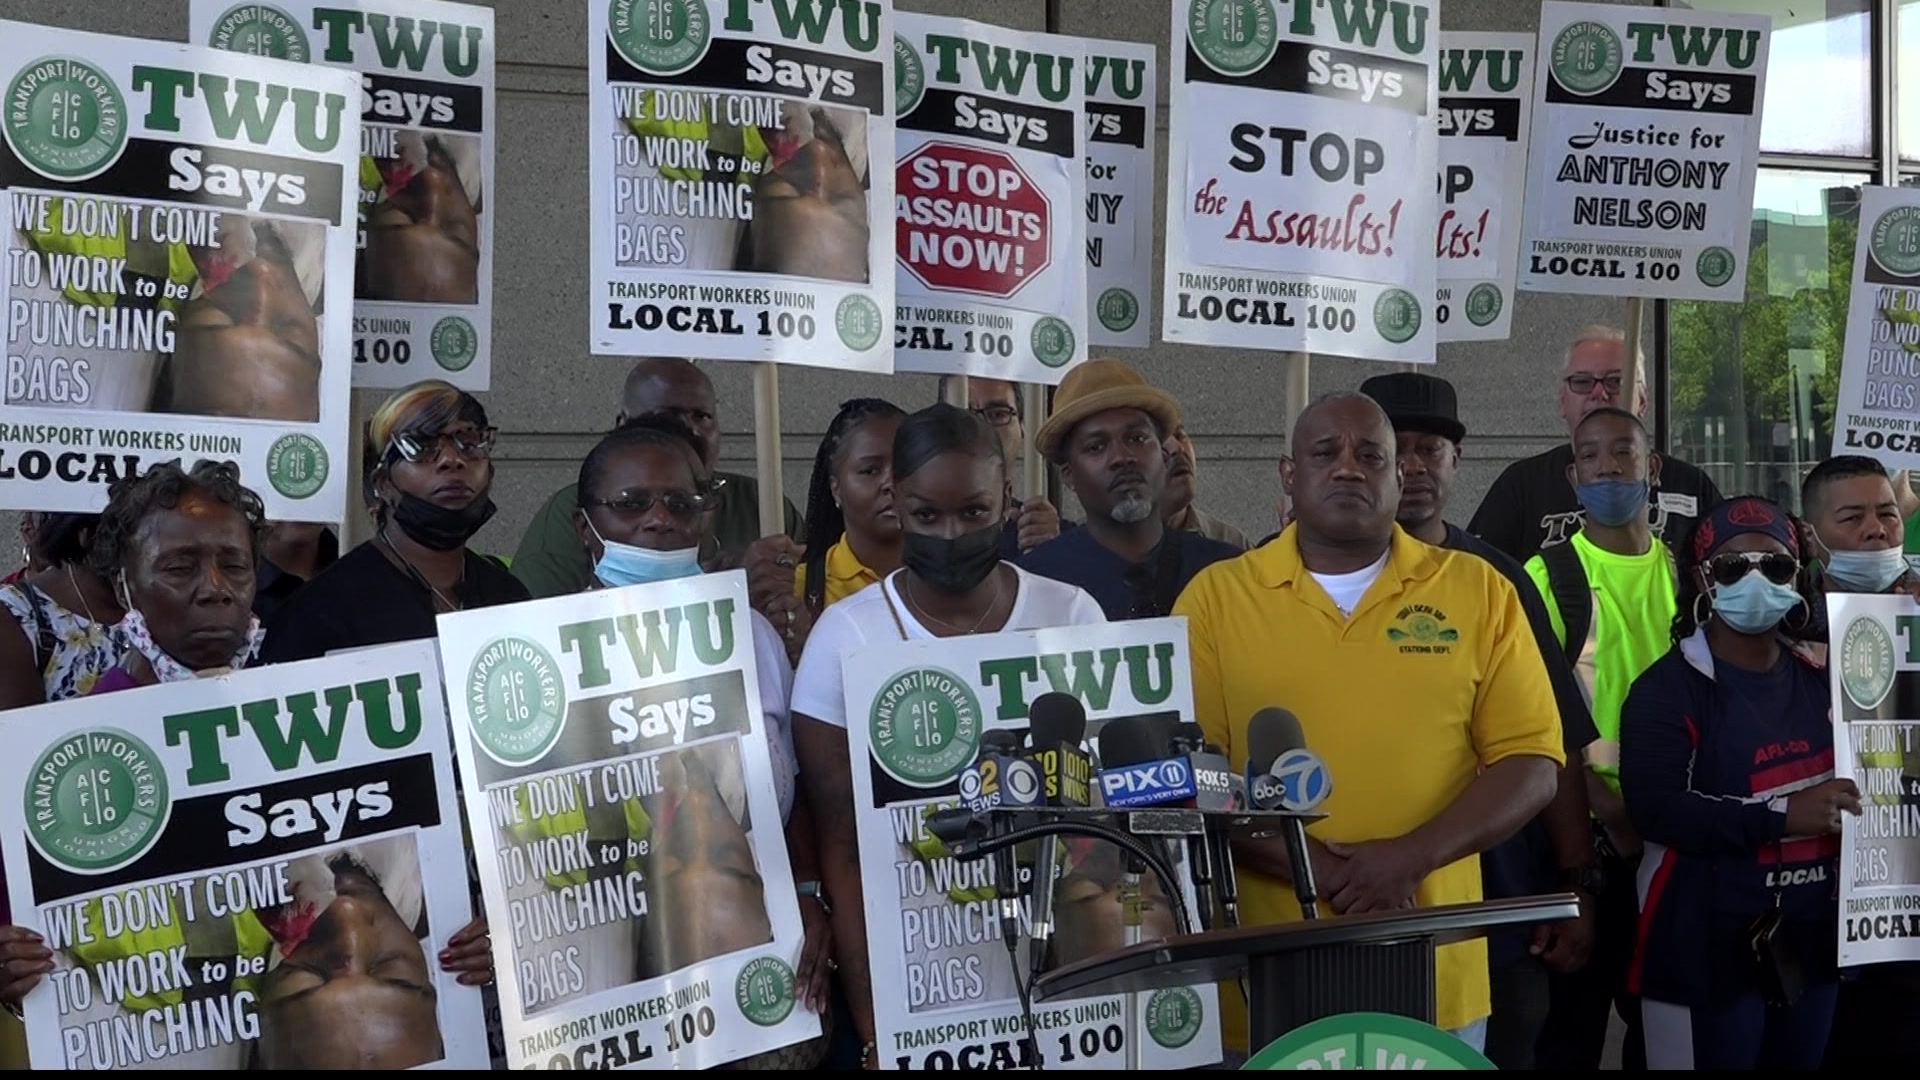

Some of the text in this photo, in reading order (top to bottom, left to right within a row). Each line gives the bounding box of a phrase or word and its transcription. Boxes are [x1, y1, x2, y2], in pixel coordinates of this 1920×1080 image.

[313, 7, 483, 78] TWU
[724, 0, 882, 53] TWU
[1290, 0, 1429, 54] TWU
[1555, 23, 1617, 69] TRANSPORT WORKERS
[1627, 22, 1760, 69] TWU
[746, 45, 855, 99] Says
[926, 33, 1074, 102] TWU
[1308, 49, 1403, 103] Says
[14, 62, 118, 138] TRANSPORT WORKERS
[132, 65, 346, 152] TWU
[361, 77, 455, 126] Says
[613, 87, 785, 130] WE DON'T COME
[1645, 71, 1732, 109] Says
[954, 96, 1048, 146] Says
[1438, 108, 1495, 136] ays
[1568, 121, 1725, 149] Justice for
[613, 135, 761, 174] TO WORK to be
[1228, 122, 1385, 187] STOP
[1556, 154, 1730, 190] ANTHONY
[168, 147, 306, 212] Says
[616, 177, 754, 220] PUNCHING
[912, 156, 1021, 200] STOP
[13, 194, 221, 248] WE DON'T COME
[896, 193, 1041, 241] ASSAULTS
[1194, 178, 1228, 214] the
[1225, 194, 1403, 258] Assaults!
[1573, 196, 1706, 231] NELSON
[1876, 207, 1910, 248] TRANSPORT
[617, 223, 687, 265] BAGS
[909, 231, 1025, 277] NOW!
[1532, 240, 1682, 260] TRANSPORT WORKERS UNION
[9, 250, 188, 299] TO WORK to be
[1177, 272, 1357, 304] TRANSPORT WORKERS UNION
[1530, 256, 1625, 279] LOCAL
[1635, 261, 1681, 281] 100
[607, 281, 815, 310] TRANSPORT WORKERS UNION
[1177, 293, 1296, 326] LOCAL
[1306, 304, 1357, 333] 100
[1878, 287, 1899, 310] WE
[9, 300, 176, 354] PUNCHING
[370, 319, 411, 335] UNION
[608, 303, 744, 335] LOCAL
[757, 310, 816, 341] 100
[914, 306, 975, 326] WORKERS
[977, 313, 1014, 330] UNION
[1872, 320, 1890, 342] TO
[354, 338, 411, 365] 100
[964, 330, 1014, 358] 100
[6, 356, 91, 404] BAGS
[1865, 380, 1915, 409] BAGS
[0, 424, 242, 455] RANSPORT WORKERS UNION
[1844, 429, 1920, 454] LOCA
[1847, 414, 1911, 433] TRANSPORT
[558, 597, 735, 690] TWU
[1845, 620, 1865, 674] TRANSPORT
[471, 641, 556, 725] TRANSPORT WORKERS
[980, 642, 1174, 721] TWU
[163, 672, 422, 786] TWU
[608, 693, 716, 745] Says
[877, 673, 972, 747] TRANSPORT WORKERS
[1852, 725, 1913, 753] WE DON'T
[34, 736, 156, 831] TRANSPORT WORKERS
[980, 760, 999, 795] 2
[1062, 749, 1089, 784] 1010
[1103, 766, 1162, 796] PIX
[1195, 768, 1229, 788] FOX 5
[1866, 767, 1905, 795] WORK
[488, 756, 664, 828] WE DON'T COME
[967, 792, 1001, 813] EWS
[1062, 775, 1089, 806] WINS
[1254, 783, 1286, 799] abc
[223, 781, 393, 847] Says
[890, 805, 929, 843] WE
[1856, 804, 1920, 838] PUNCHIN
[500, 829, 649, 888] TO WORK to be
[895, 861, 926, 899] TO
[1766, 866, 1828, 888] LOCAL
[1854, 848, 1888, 882] BAGS
[44, 862, 295, 950] WE DON'T COME
[509, 870, 649, 949] PUNCHING
[1846, 896, 1890, 914] TRANSPORT
[51, 945, 265, 1015] TO WORK to be
[521, 945, 585, 1010] BAGS
[740, 960, 761, 1008] TRANSPORT
[907, 956, 984, 1007] BAGS
[61, 990, 261, 1070] PUNCHING
[519, 979, 712, 1059] TRANSPORT WORKERS UNION
[664, 1005, 716, 1052] 100
[893, 1019, 989, 1051] TRANSPORT
[1075, 1000, 1121, 1024] UNION
[1058, 1024, 1124, 1062] 100
